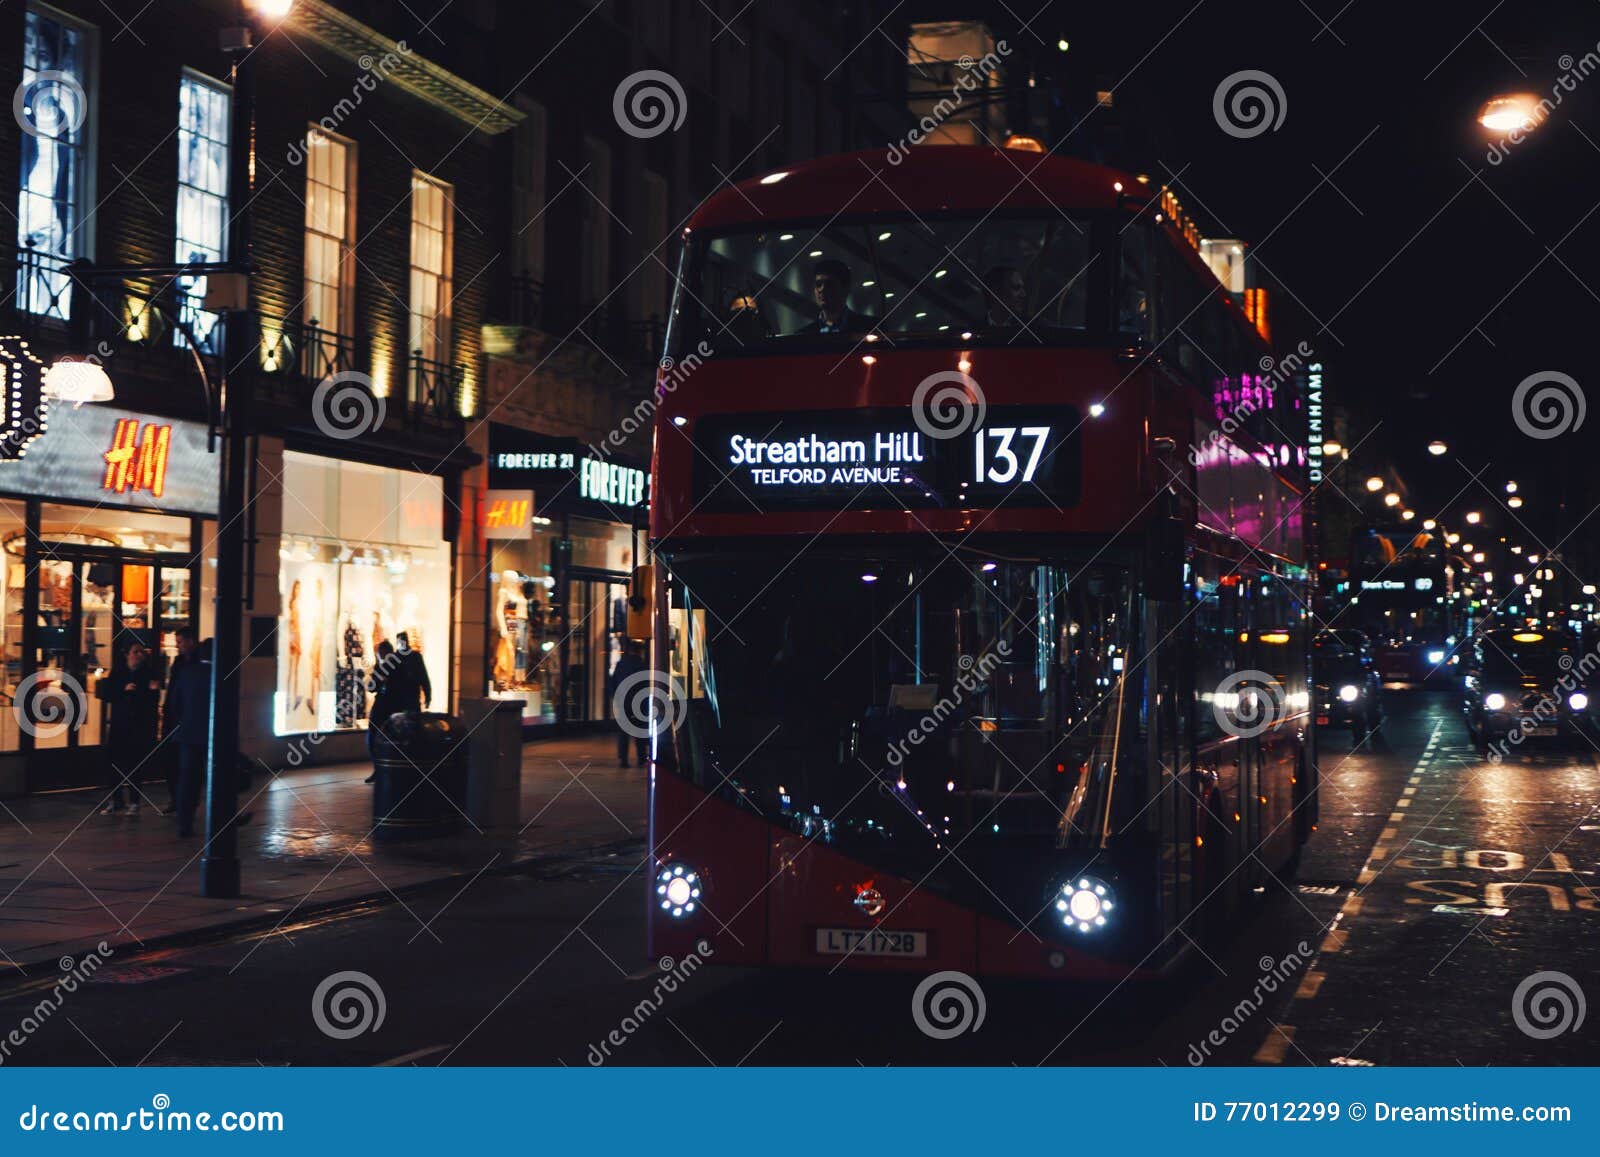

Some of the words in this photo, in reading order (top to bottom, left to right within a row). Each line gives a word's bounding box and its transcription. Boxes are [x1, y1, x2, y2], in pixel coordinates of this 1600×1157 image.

[1309, 363, 1322, 482] DEBENHAMS
[104, 418, 172, 498] H&M
[498, 453, 557, 468] FOREVER
[559, 453, 574, 468] 21
[730, 434, 866, 463] Streatham
[875, 432, 923, 461] Hill
[975, 426, 1051, 483] 137
[581, 458, 645, 506] FOREVER
[751, 468, 826, 484] TELFORD
[831, 467, 901, 483] AVENUE
